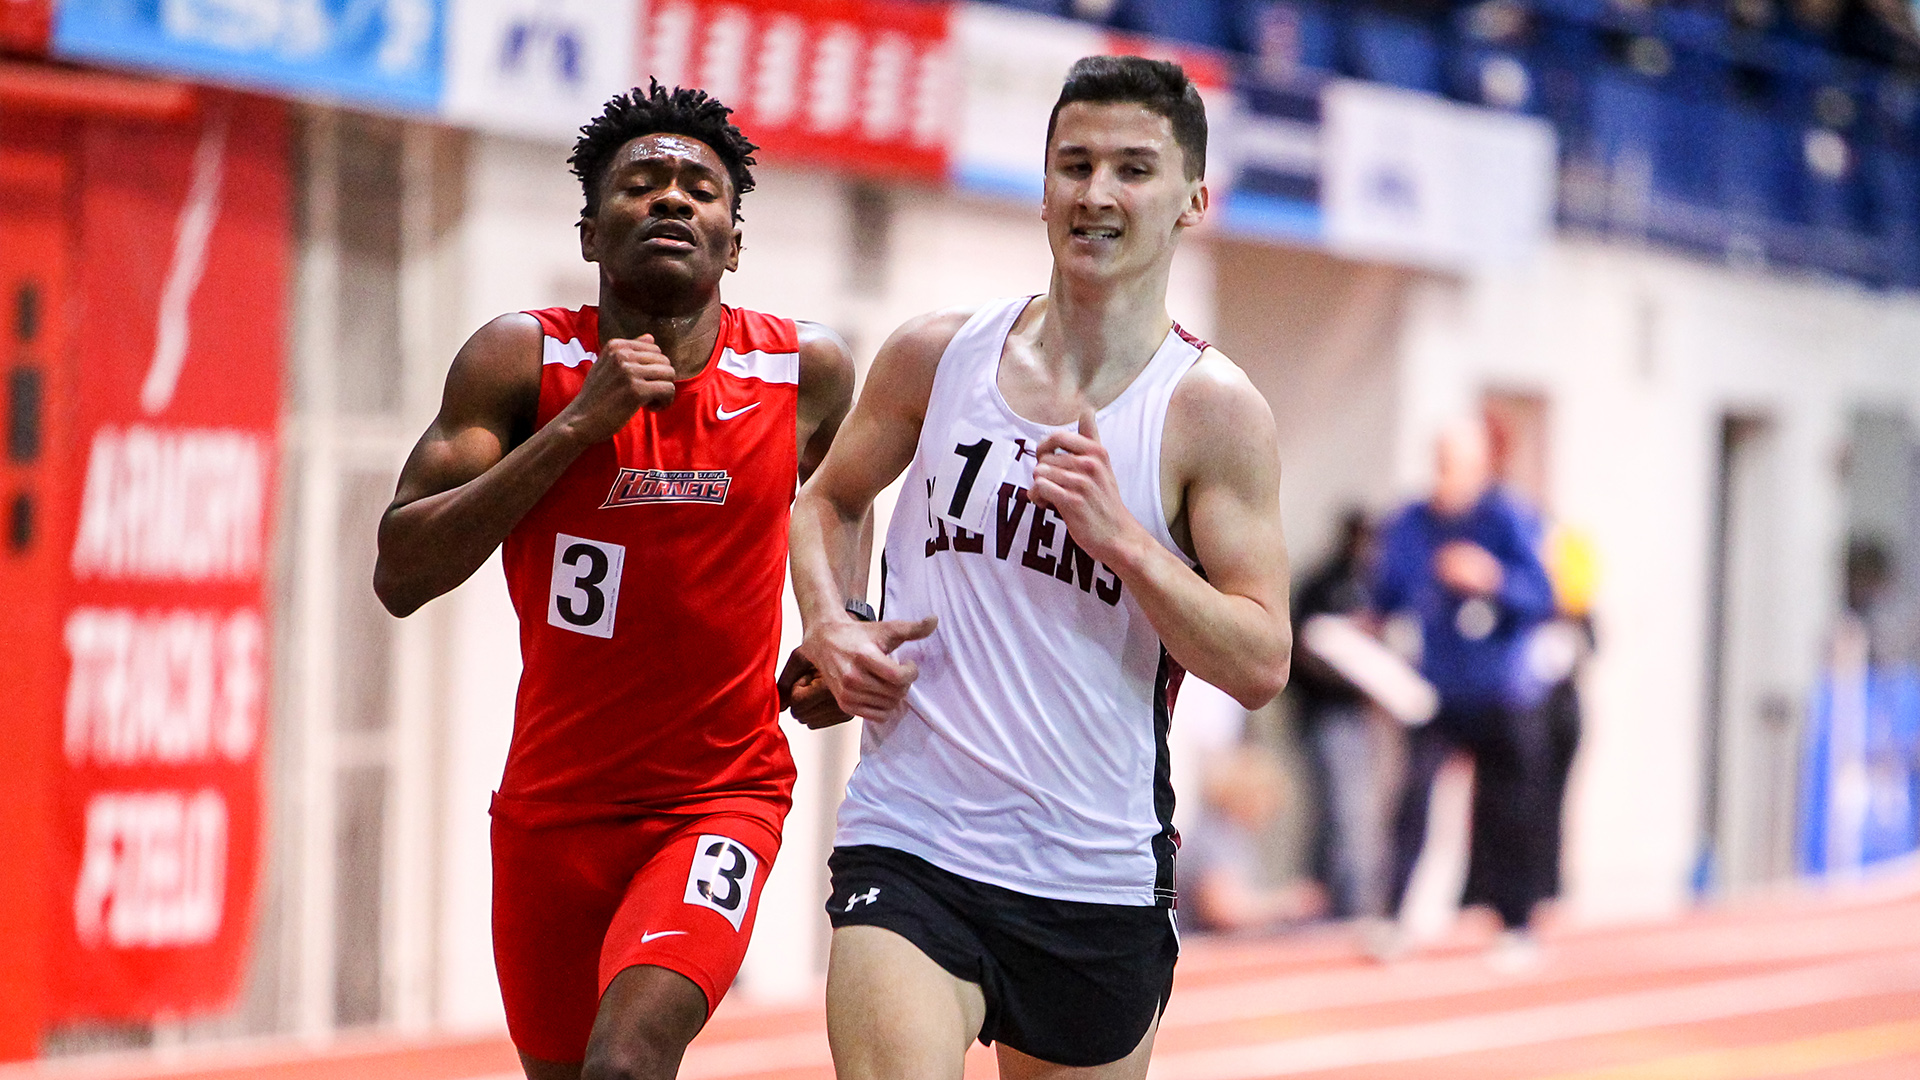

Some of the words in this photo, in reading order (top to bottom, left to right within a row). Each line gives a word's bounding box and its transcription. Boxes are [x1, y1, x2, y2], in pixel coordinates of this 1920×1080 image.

[606, 470, 728, 504] HORNETS
[947, 437, 994, 520] 1
[556, 543, 609, 627] 3
[697, 841, 747, 911] 3
